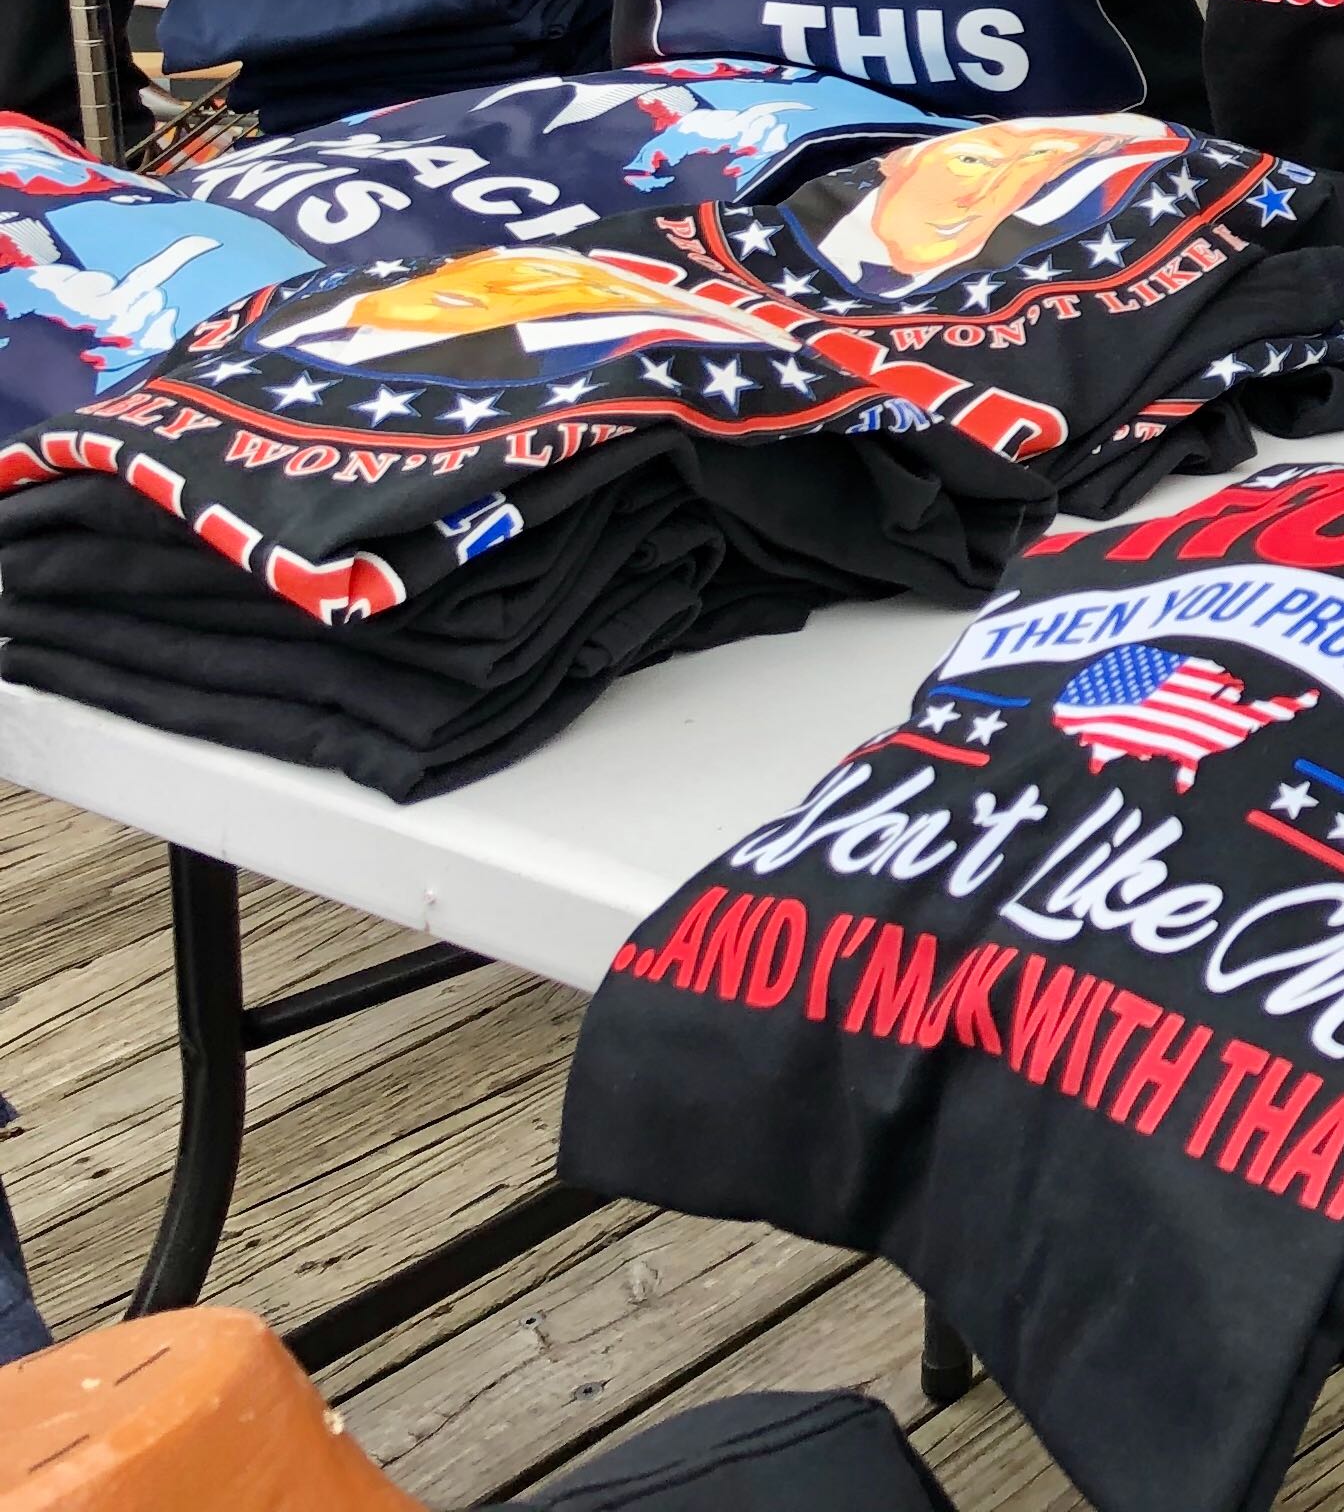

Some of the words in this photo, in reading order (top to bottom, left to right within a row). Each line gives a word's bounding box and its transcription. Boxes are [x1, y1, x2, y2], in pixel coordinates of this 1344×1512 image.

[761, 0, 1031, 92] THIS
[890, 291, 1081, 353] WON'T
[1100, 242, 1228, 316] LIKE
[224, 428, 480, 484] WON'T
[983, 600, 1136, 661] THEN
[1157, 578, 1262, 631] YOU
[999, 787, 1224, 954] Like
[997, 953, 1213, 1137] WITH
